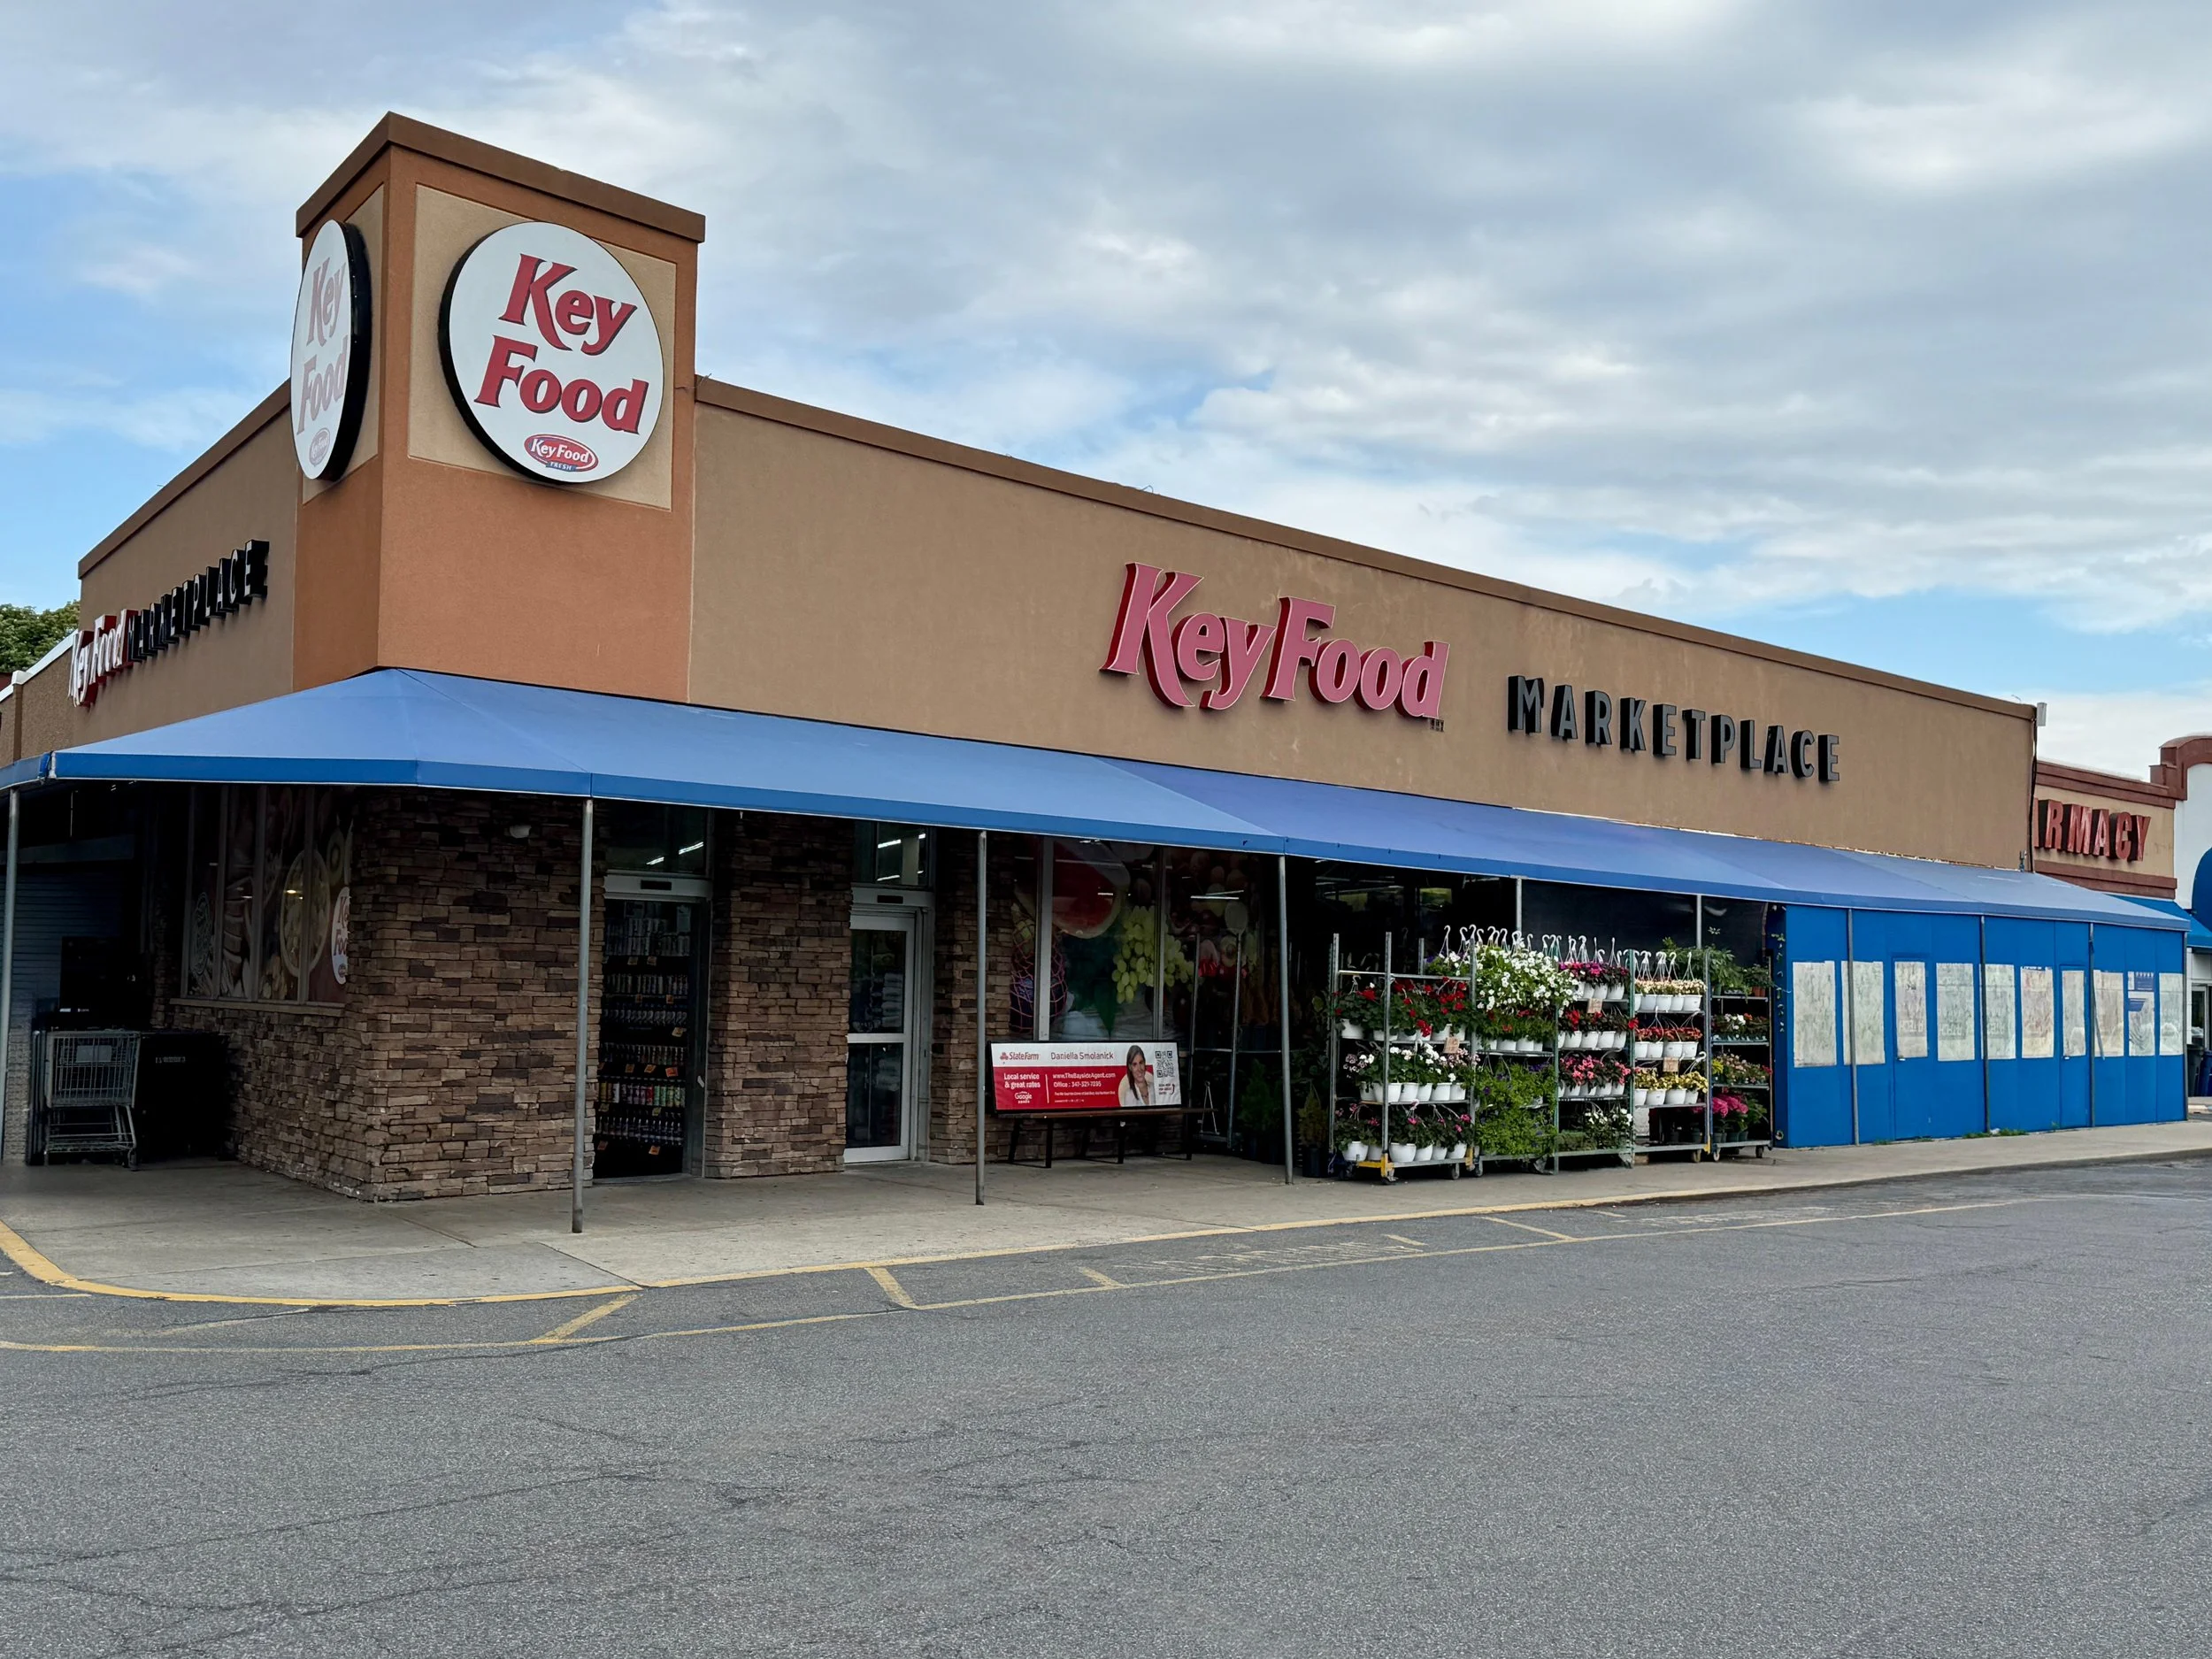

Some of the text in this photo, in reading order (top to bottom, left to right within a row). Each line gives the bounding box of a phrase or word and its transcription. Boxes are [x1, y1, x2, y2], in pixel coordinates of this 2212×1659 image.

[307, 257, 346, 347] Key
[498, 252, 638, 356] Key
[296, 334, 348, 435] Food
[474, 334, 649, 435] Food
[530, 438, 590, 464] Key Food
[549, 461, 572, 472] FRESH
[88, 609, 139, 681] Food
[1100, 562, 1451, 719] Key Food
[1508, 674, 1841, 782] MARKETPLACE
[1010, 1081, 1025, 1090] great
[1050, 1051, 1079, 1060] Daniella
